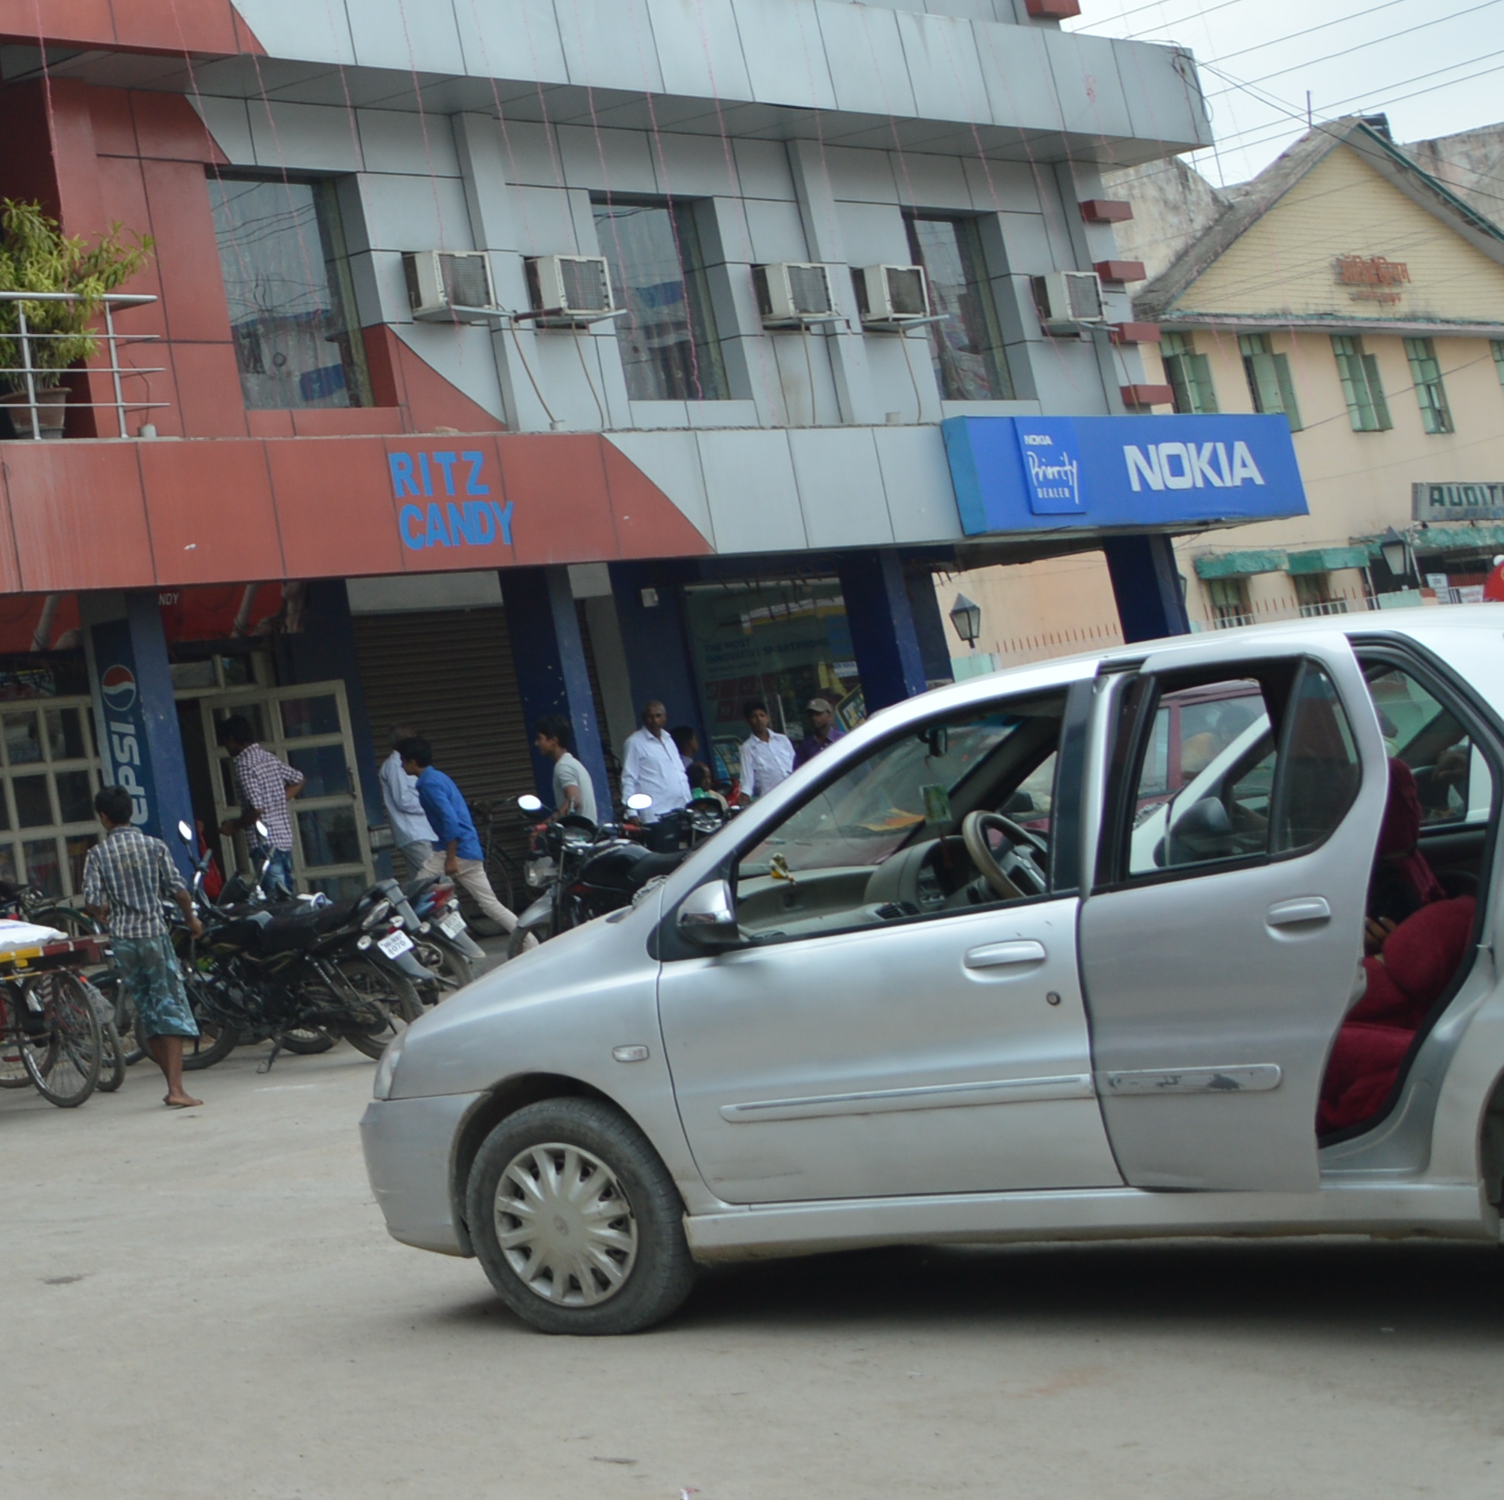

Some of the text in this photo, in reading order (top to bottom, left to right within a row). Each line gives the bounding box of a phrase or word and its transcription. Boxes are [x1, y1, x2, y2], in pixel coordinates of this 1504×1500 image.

[1024, 434, 1053, 446] NOKIA
[389, 451, 490, 498] RITZ
[1027, 451, 1080, 504] Priority
[1123, 441, 1265, 492] NOKIA
[1037, 487, 1071, 499] DEALER
[1429, 484, 1504, 507] AUDIT
[399, 501, 514, 551] CANDY
[109, 720, 149, 833] EPSI
